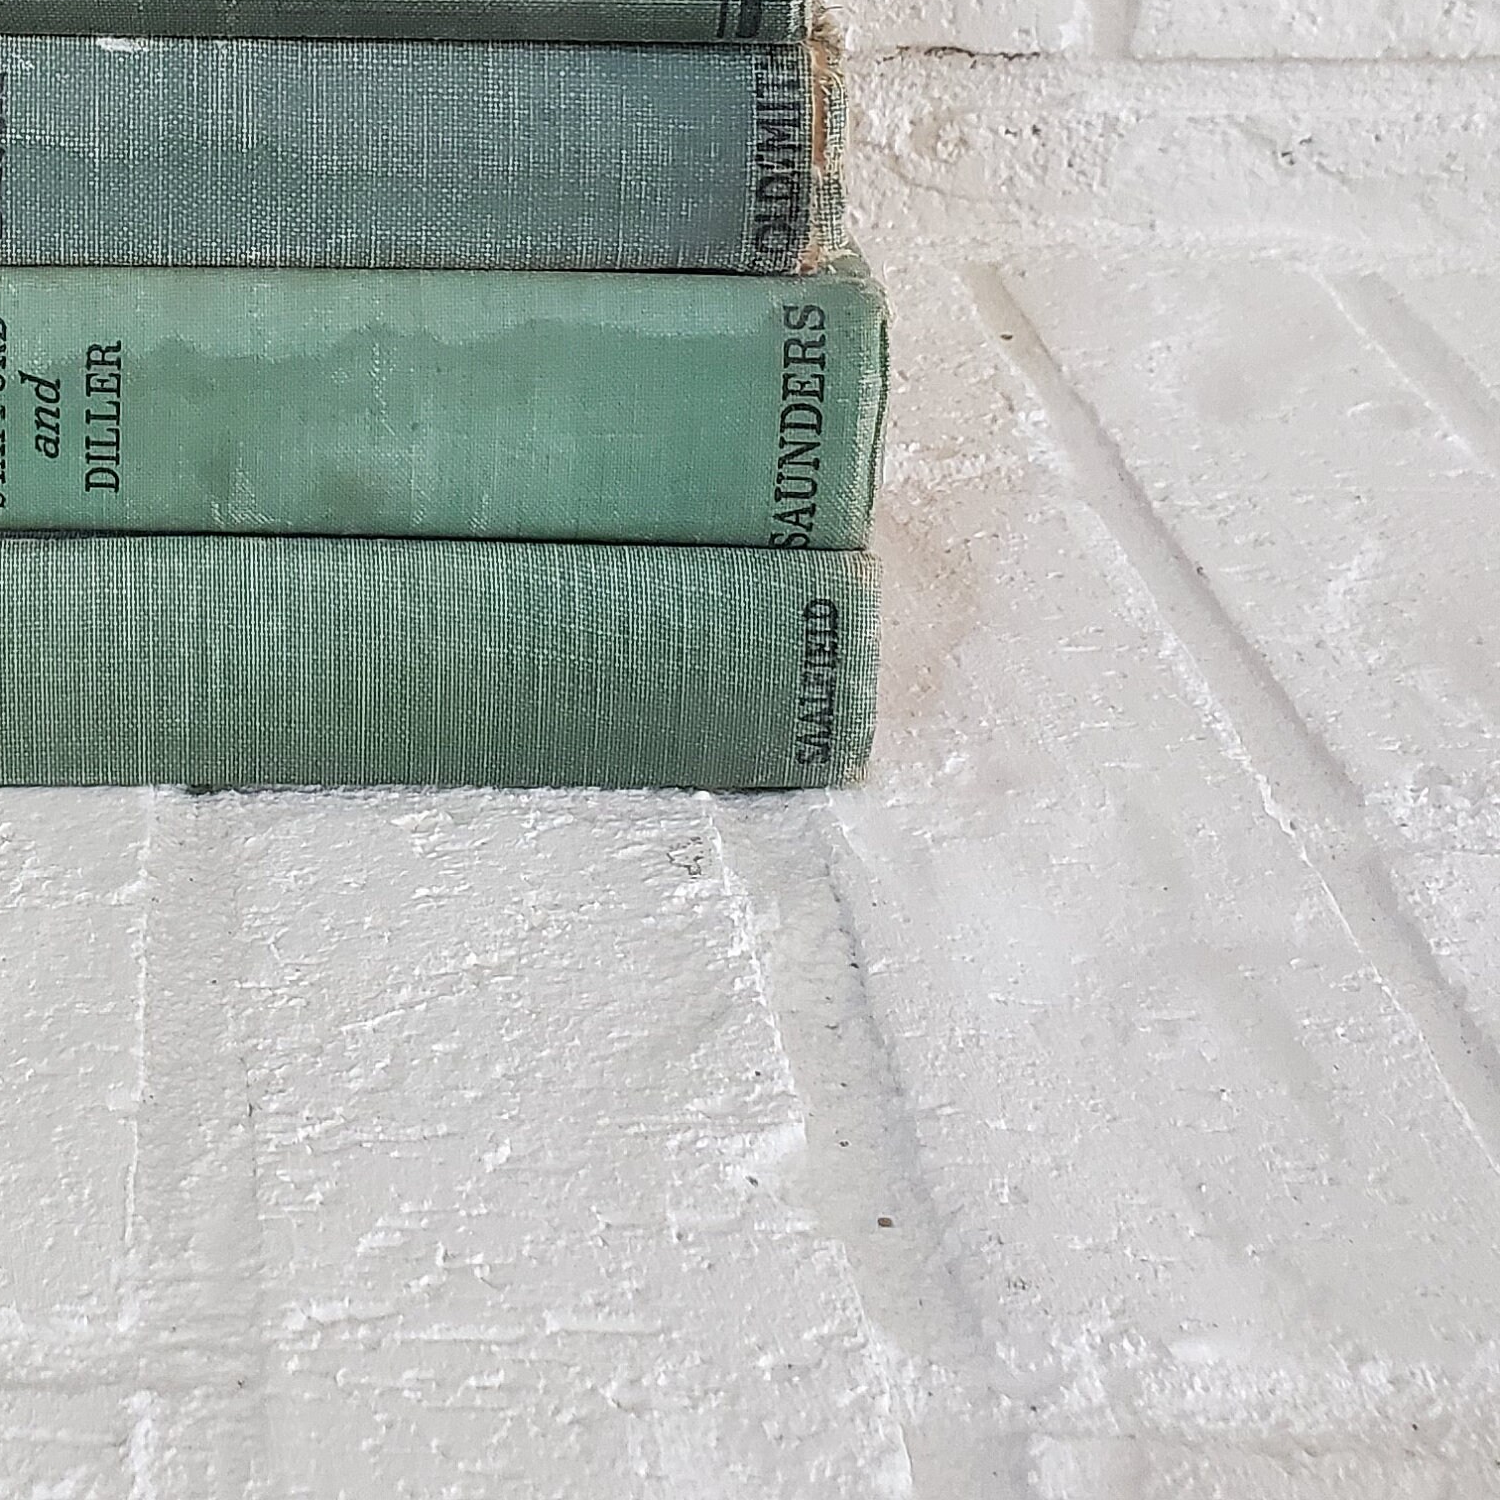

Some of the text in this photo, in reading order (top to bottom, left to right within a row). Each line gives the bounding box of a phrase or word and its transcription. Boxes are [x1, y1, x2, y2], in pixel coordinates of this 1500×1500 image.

[17, 369, 61, 459] and
[85, 339, 122, 494] DILLER
[769, 303, 827, 549] SAUNDERS
[796, 597, 839, 765] SAALFIELD
